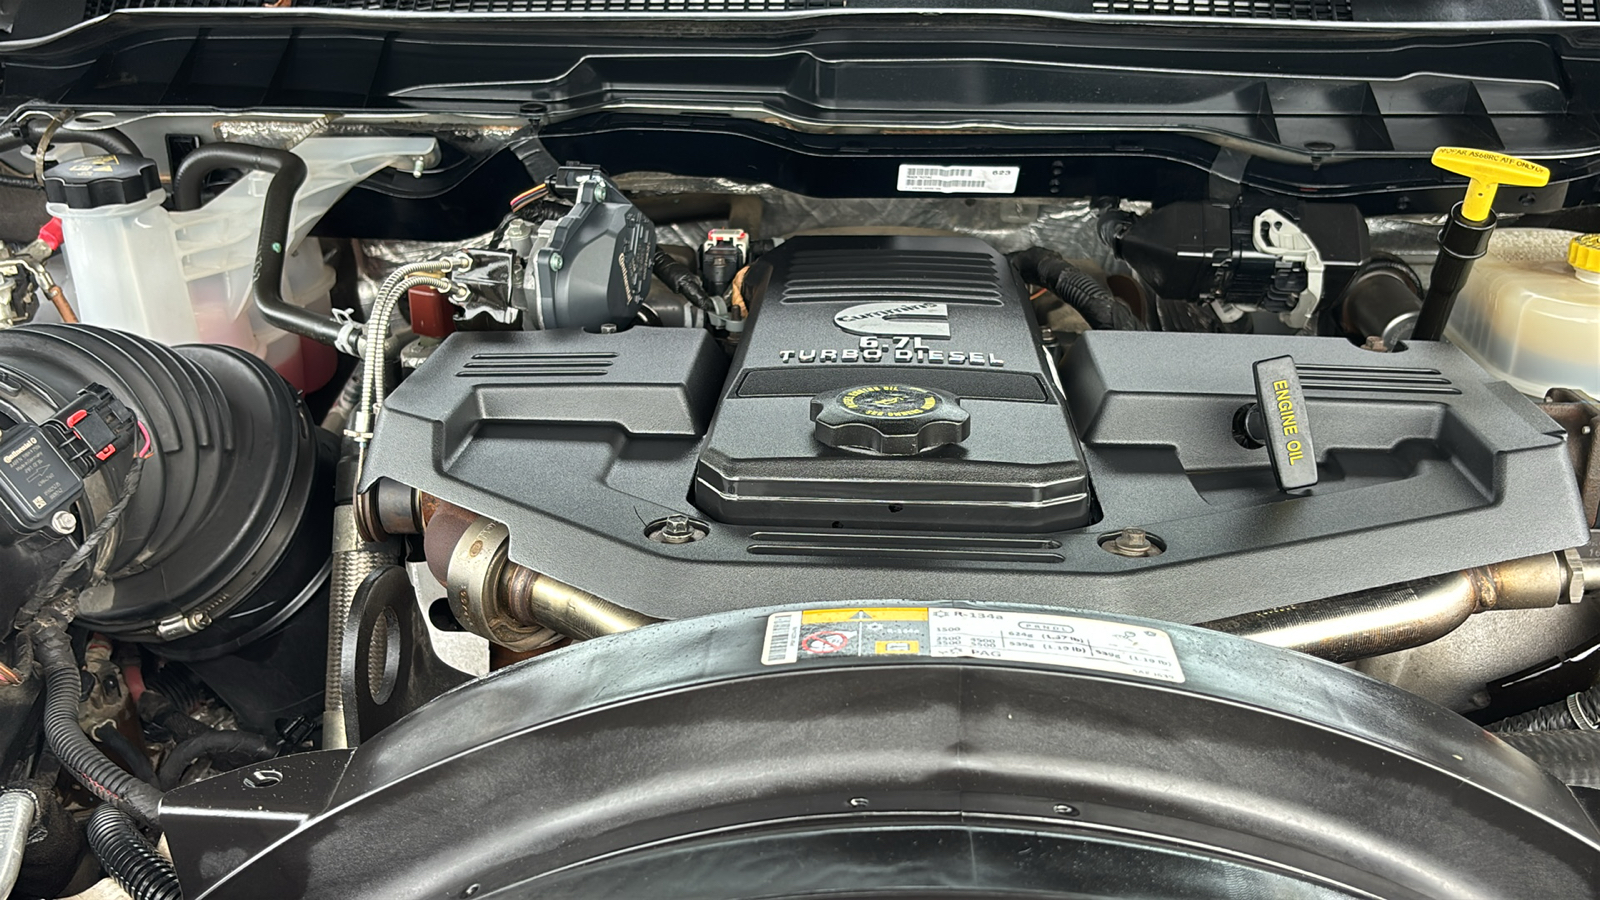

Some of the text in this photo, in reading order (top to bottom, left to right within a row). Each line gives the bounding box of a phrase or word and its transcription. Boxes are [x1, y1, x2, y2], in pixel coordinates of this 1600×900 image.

[1500, 157, 1515, 165] ATF
[836, 302, 938, 322] Cummins
[859, 336, 930, 352] 6.7L
[779, 349, 1004, 366] TURBO DIESEL
[1272, 379, 1304, 466] ENGINE OIL
[954, 611, 1003, 620] R-134a
[971, 649, 1002, 657] PAG
